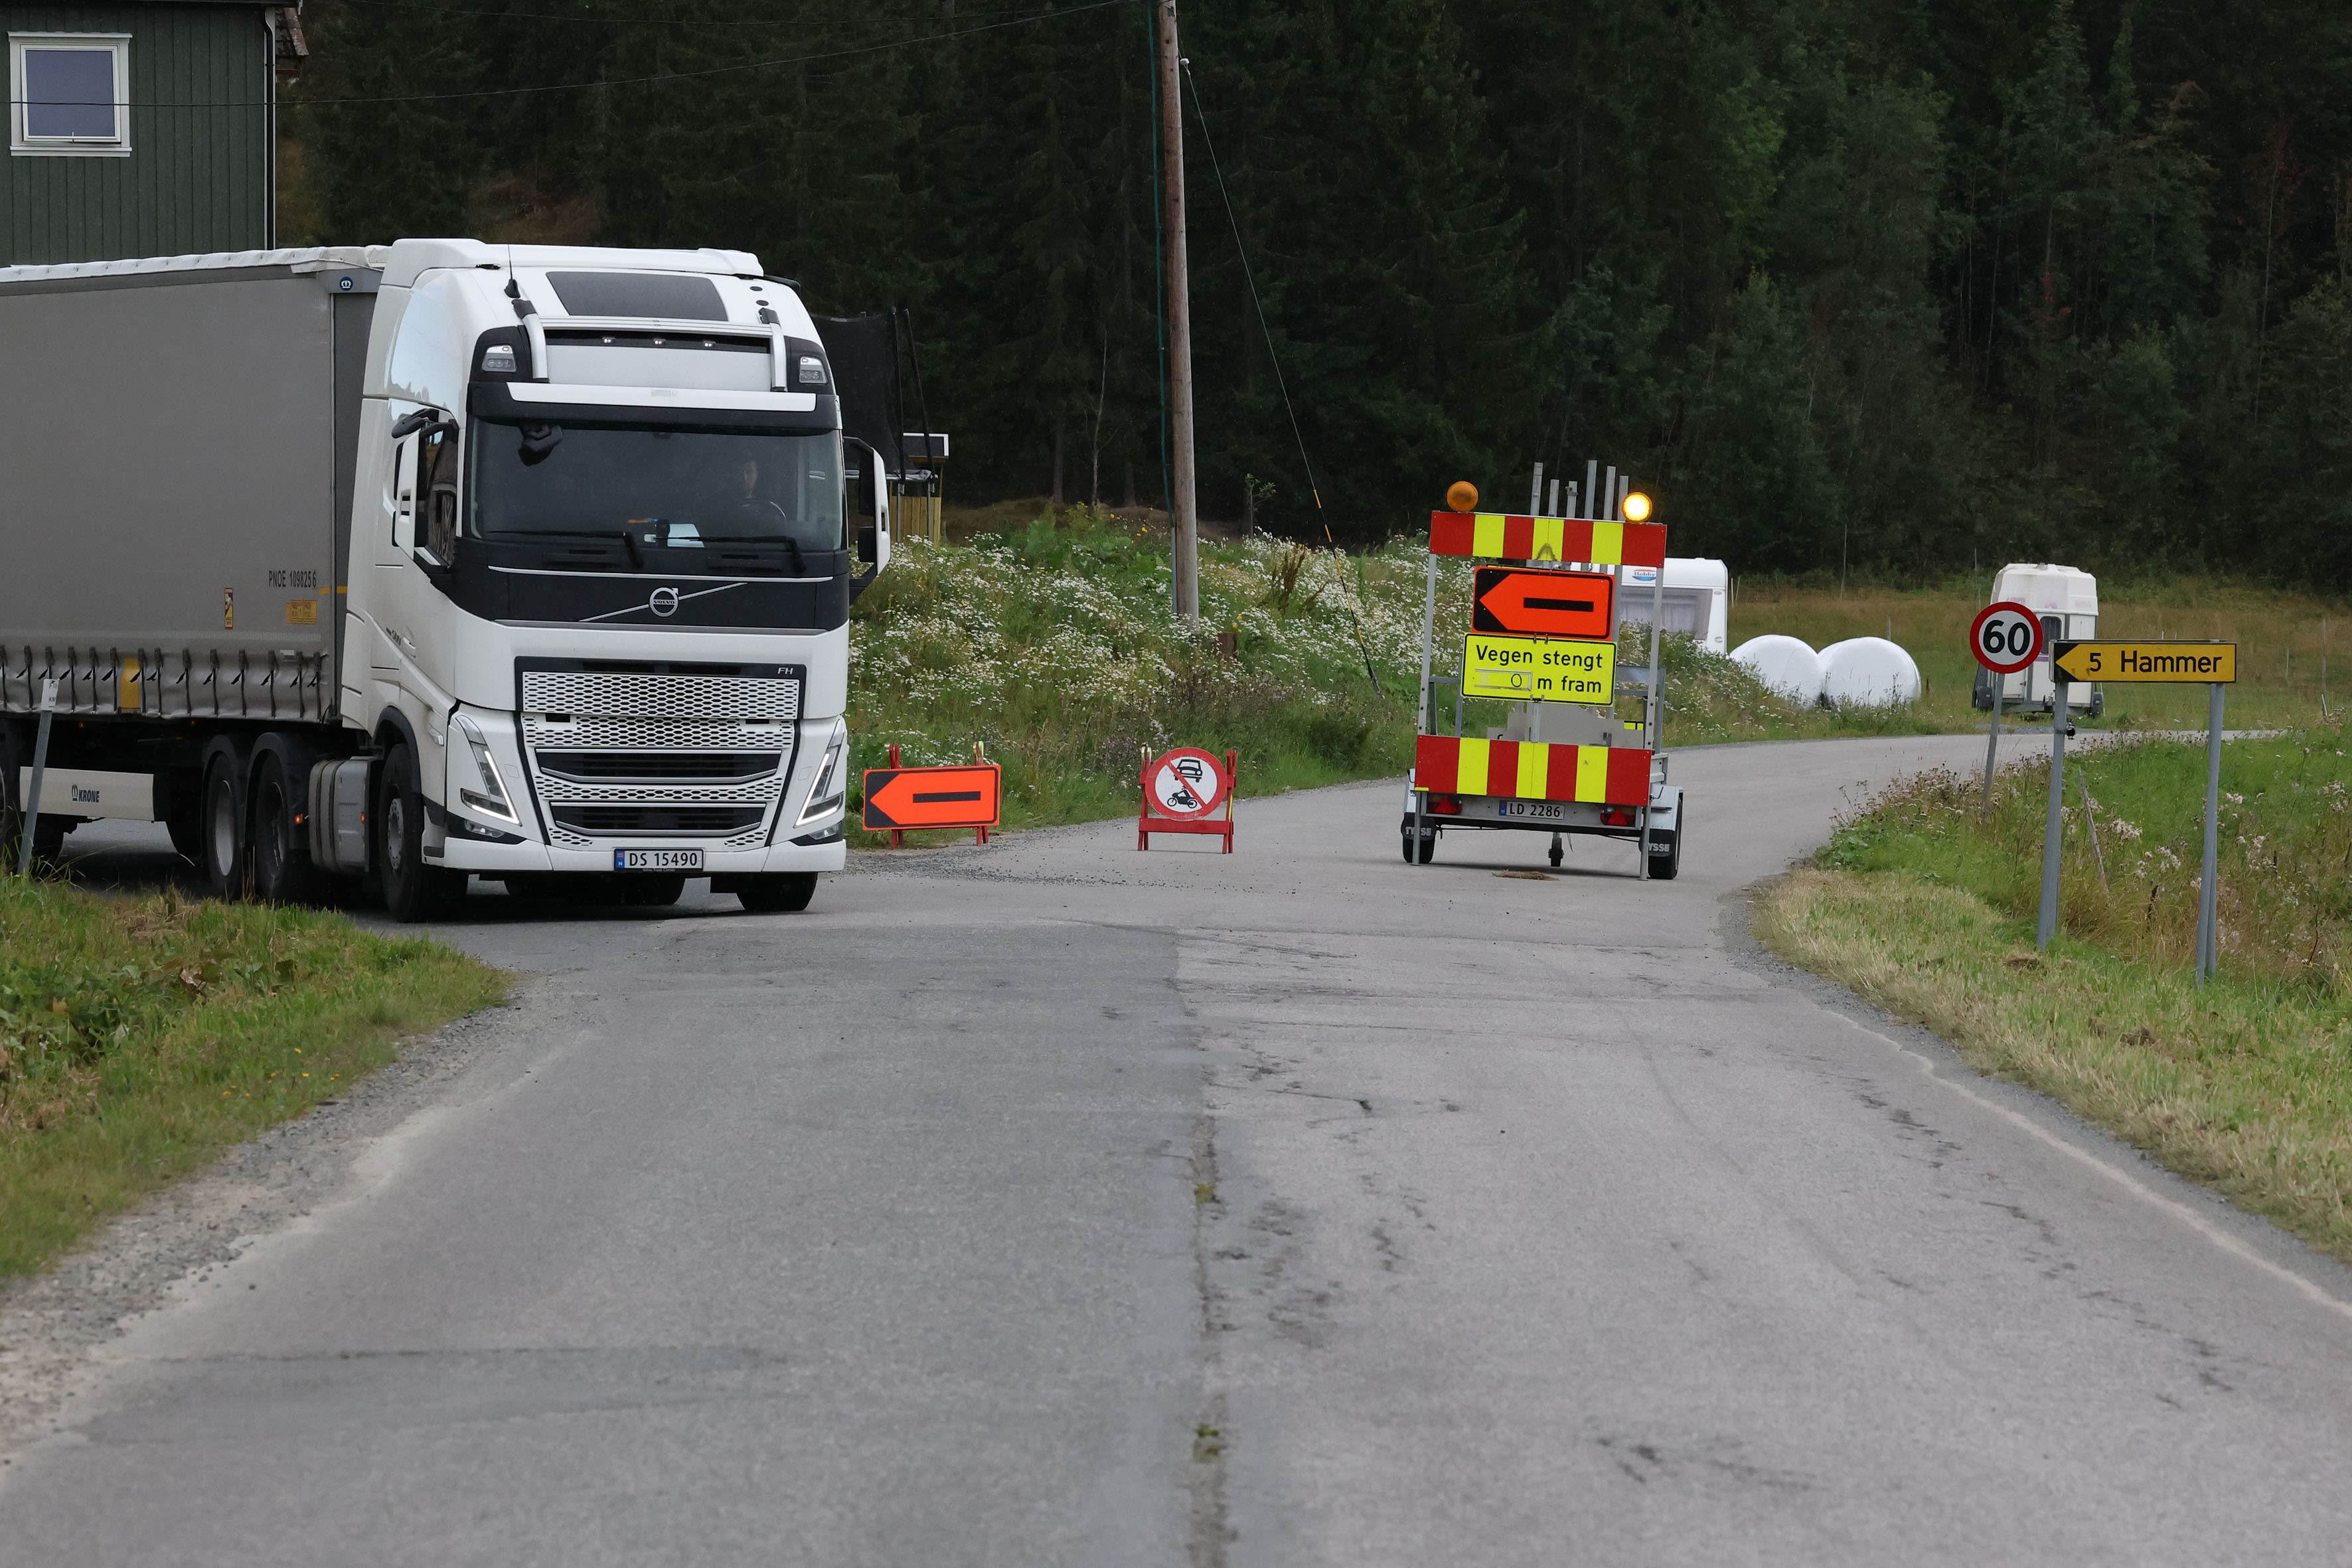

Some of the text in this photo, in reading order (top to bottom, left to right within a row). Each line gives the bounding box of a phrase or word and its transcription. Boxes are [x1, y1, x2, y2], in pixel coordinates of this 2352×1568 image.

[269, 570, 317, 588] PNOE 1098256
[1983, 619, 2030, 656] 60
[1476, 645, 1603, 671] Vegen stengt
[2090, 650, 2223, 673] 5 Hammer
[1511, 673, 1601, 693] 0 m fram
[79, 789, 100, 803] KRONE
[1510, 803, 1560, 817] LD 2286
[1405, 826, 1432, 836] TYSE
[1648, 842, 1670, 852] YSSE
[629, 852, 697, 866] DS 15490
